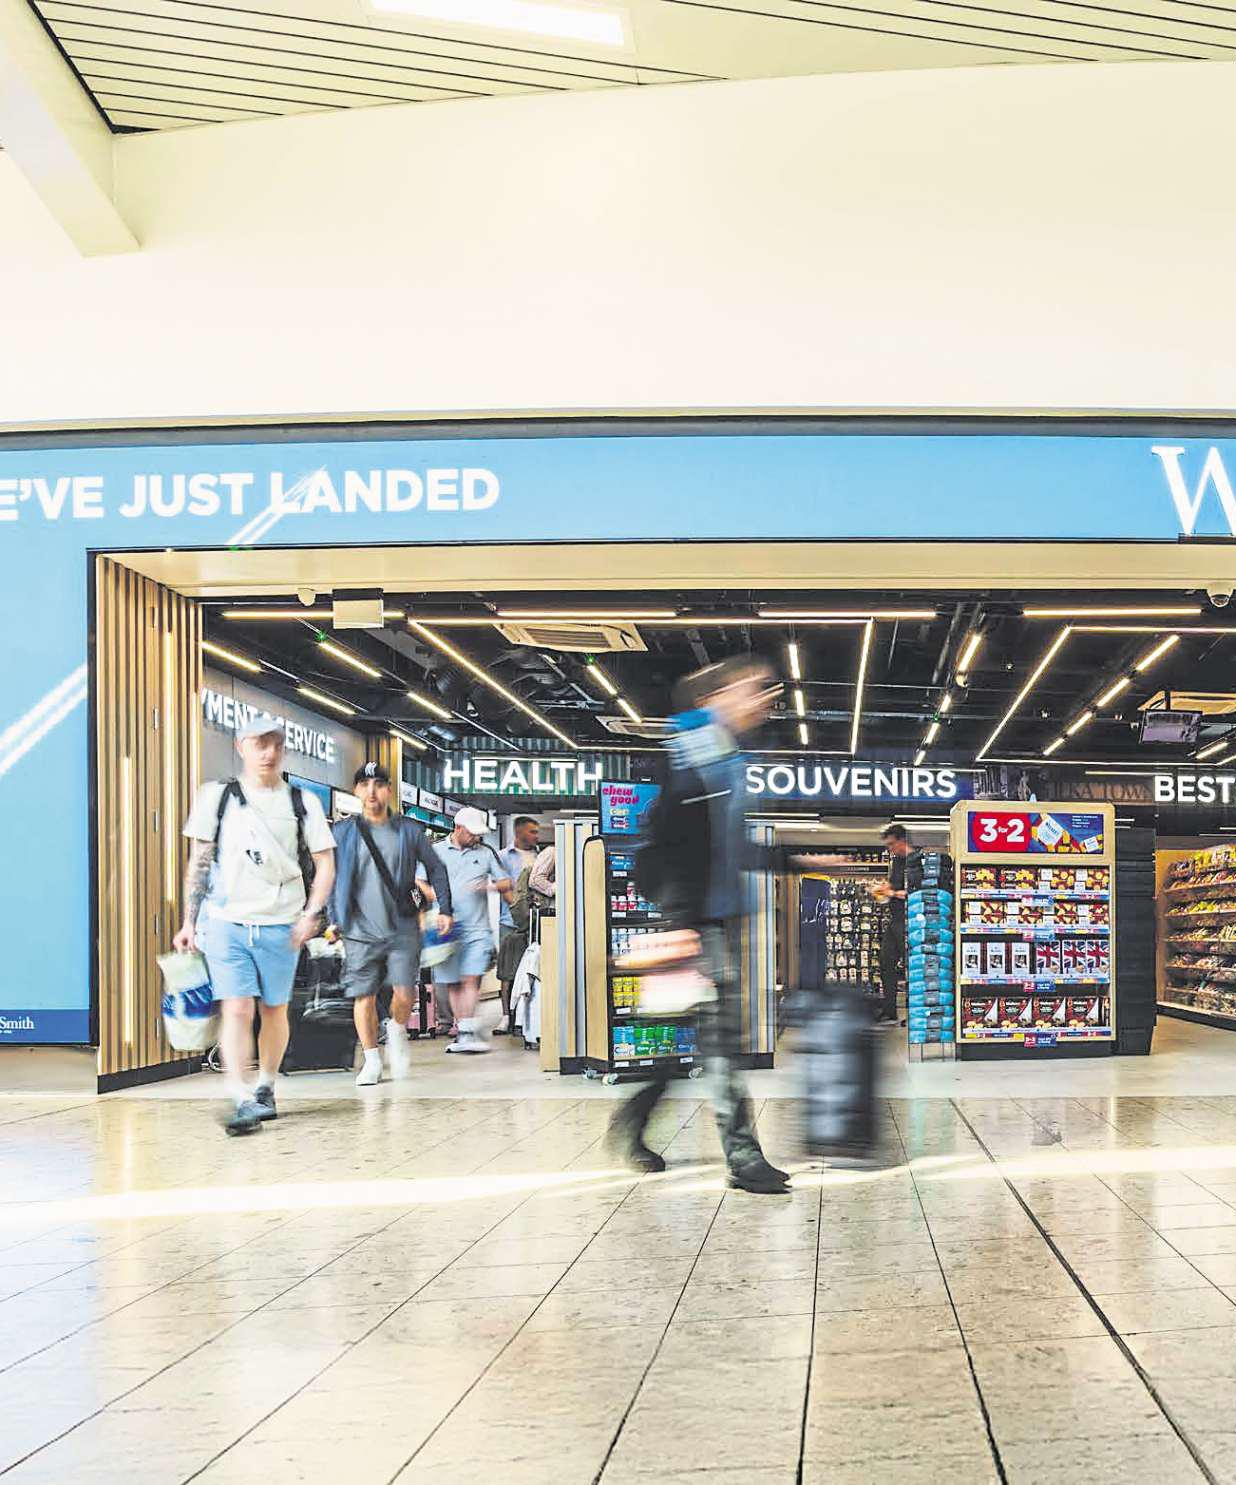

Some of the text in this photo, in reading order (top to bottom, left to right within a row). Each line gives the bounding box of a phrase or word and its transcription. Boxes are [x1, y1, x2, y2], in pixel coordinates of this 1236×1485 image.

[118, 472, 253, 518] JUST
[271, 468, 501, 515] LANDED
[442, 759, 603, 792] HEALTH
[602, 784, 633, 796] chew
[745, 765, 958, 799] SOUVENIRS
[979, 818, 998, 843] 3
[1006, 818, 1025, 843] 2
